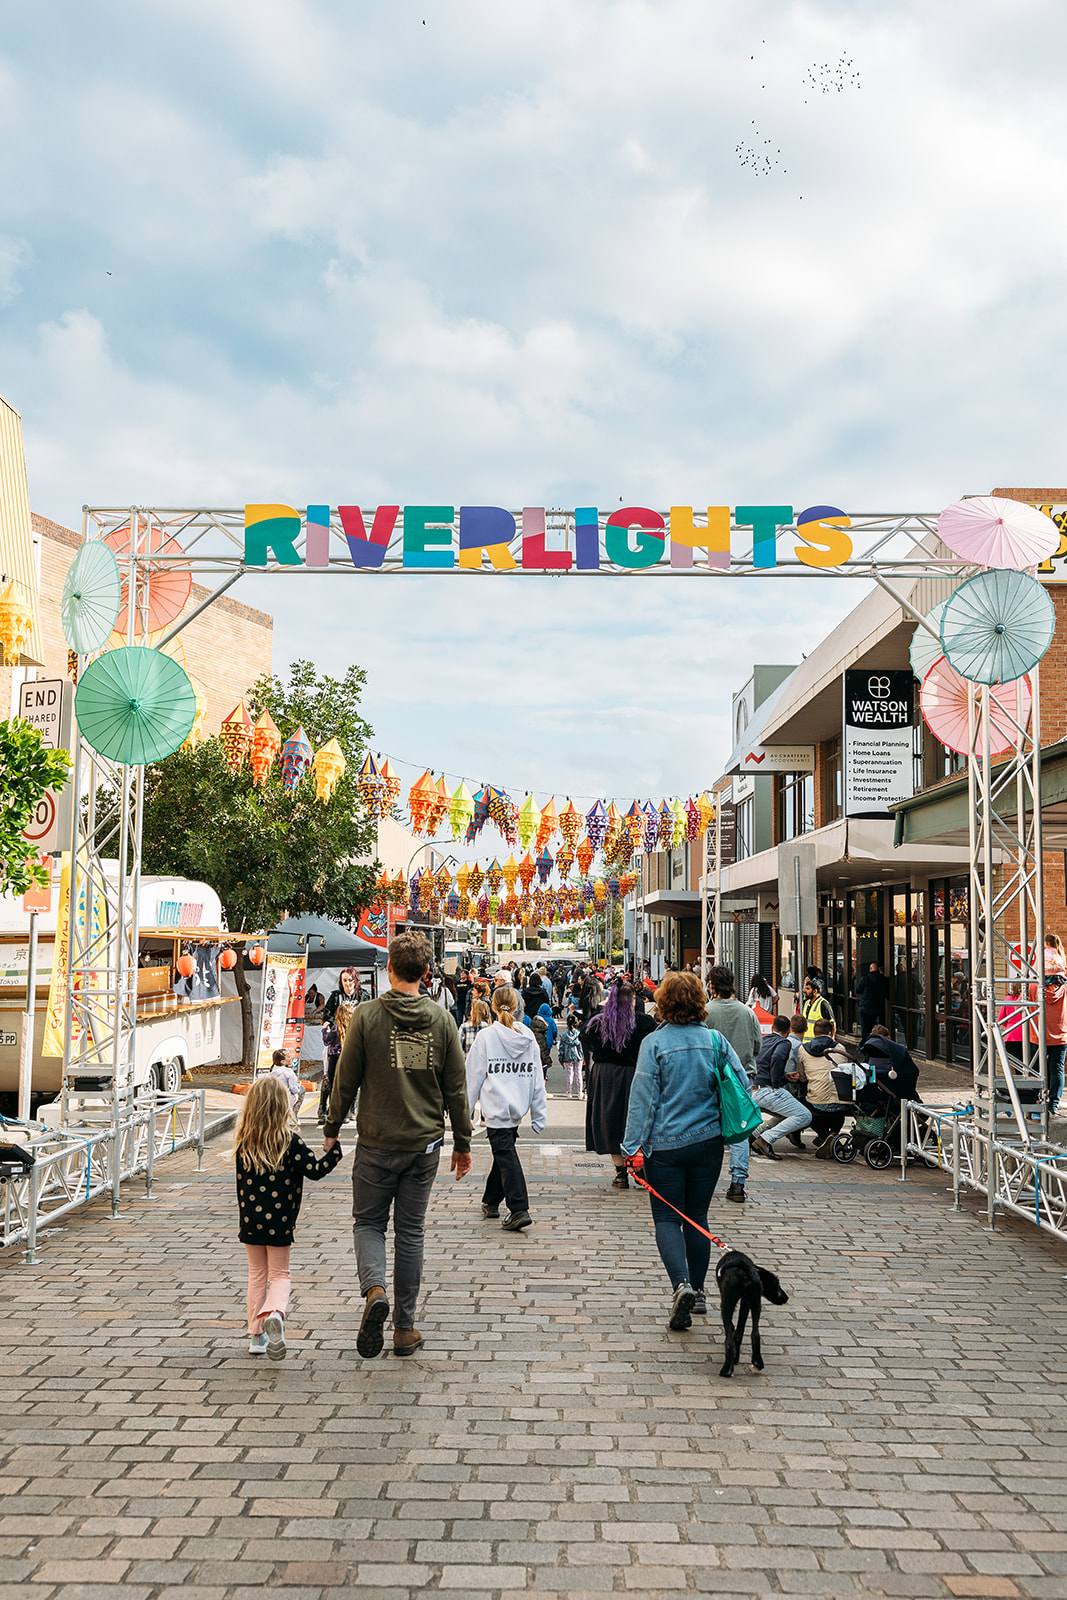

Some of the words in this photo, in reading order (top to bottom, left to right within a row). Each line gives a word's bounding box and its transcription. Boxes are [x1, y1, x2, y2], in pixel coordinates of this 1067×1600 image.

[243, 503, 854, 569] RIVERLIGHTS
[25, 689, 57, 707] END
[851, 700, 908, 712] WATSON
[851, 711, 908, 723] WEALTH
[881, 740, 910, 748] Planning
[866, 767, 898, 775] Insurance
[488, 1062, 534, 1074] LEISURE
